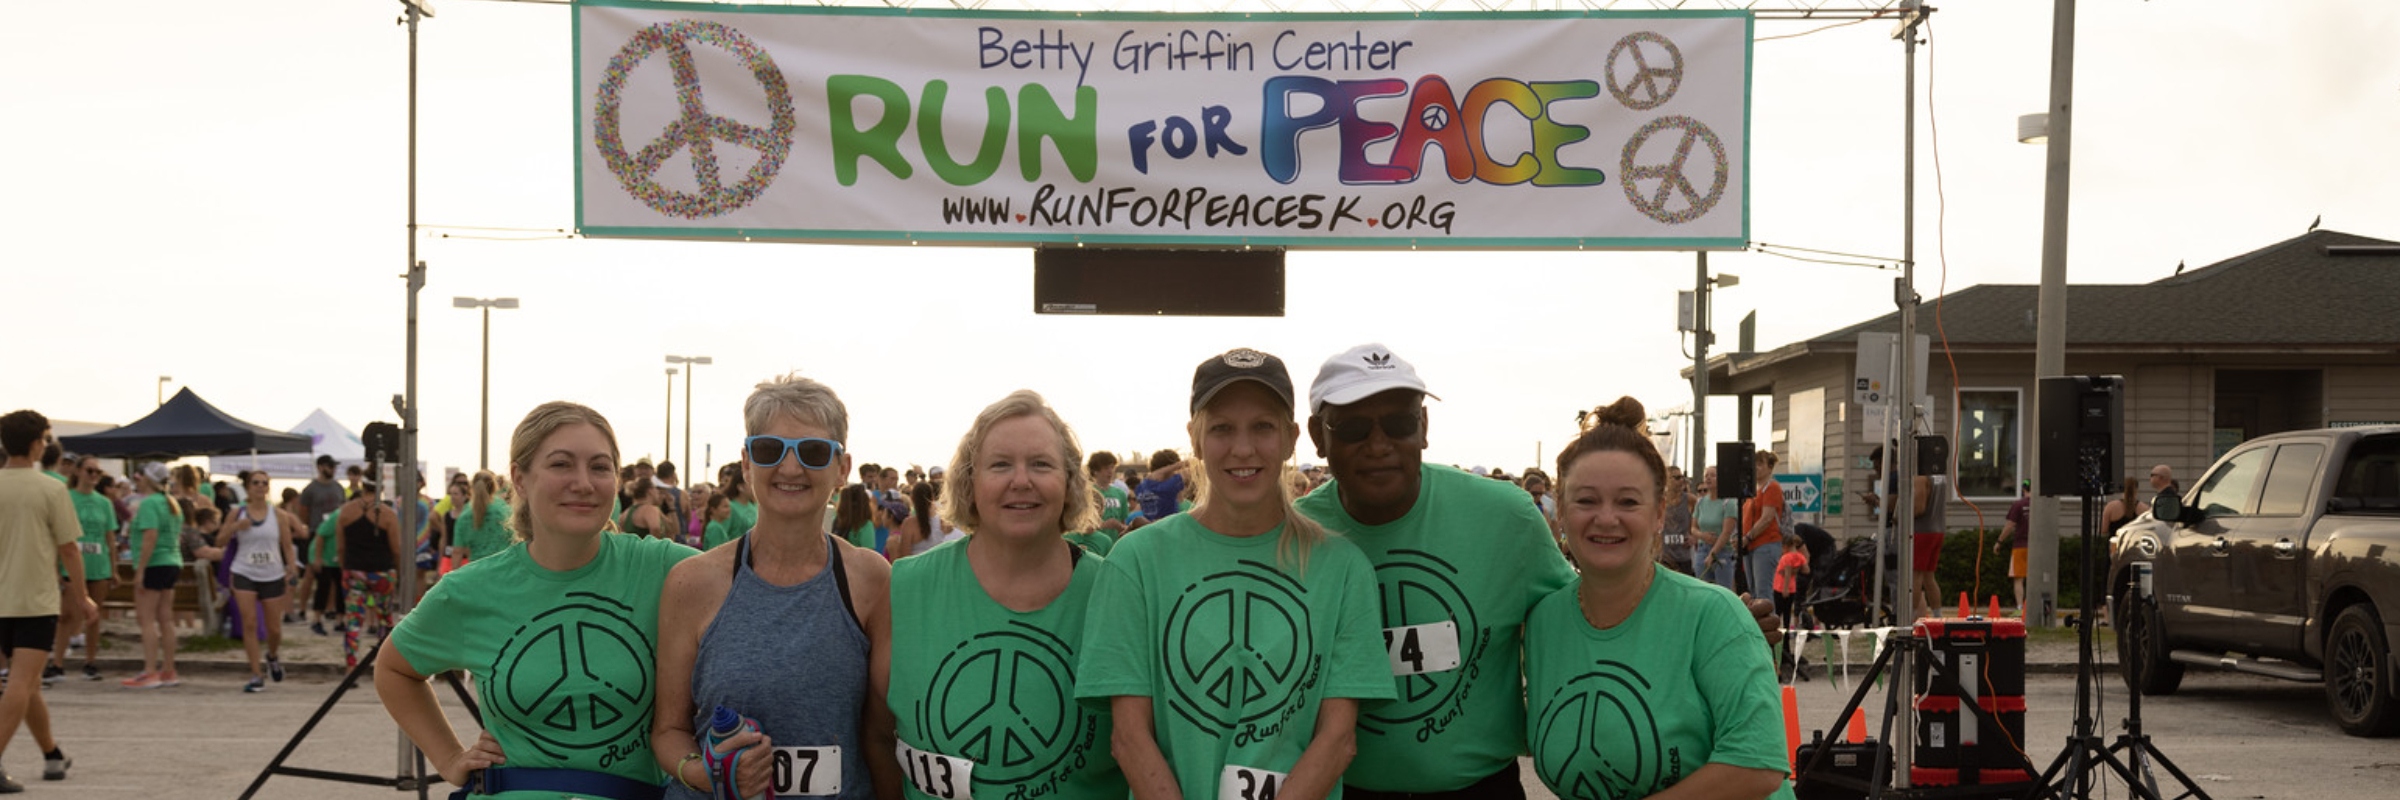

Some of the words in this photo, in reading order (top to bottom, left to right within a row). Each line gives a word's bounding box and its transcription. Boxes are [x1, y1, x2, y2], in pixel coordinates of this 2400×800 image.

[978, 26, 1094, 88] Betty
[1113, 29, 1254, 74] Griffin
[1272, 30, 1413, 71] Center
[826, 74, 1098, 187] RUN
[1128, 106, 1248, 175] FOR
[1260, 74, 1606, 187] PEACE
[906, 748, 955, 800] 113
